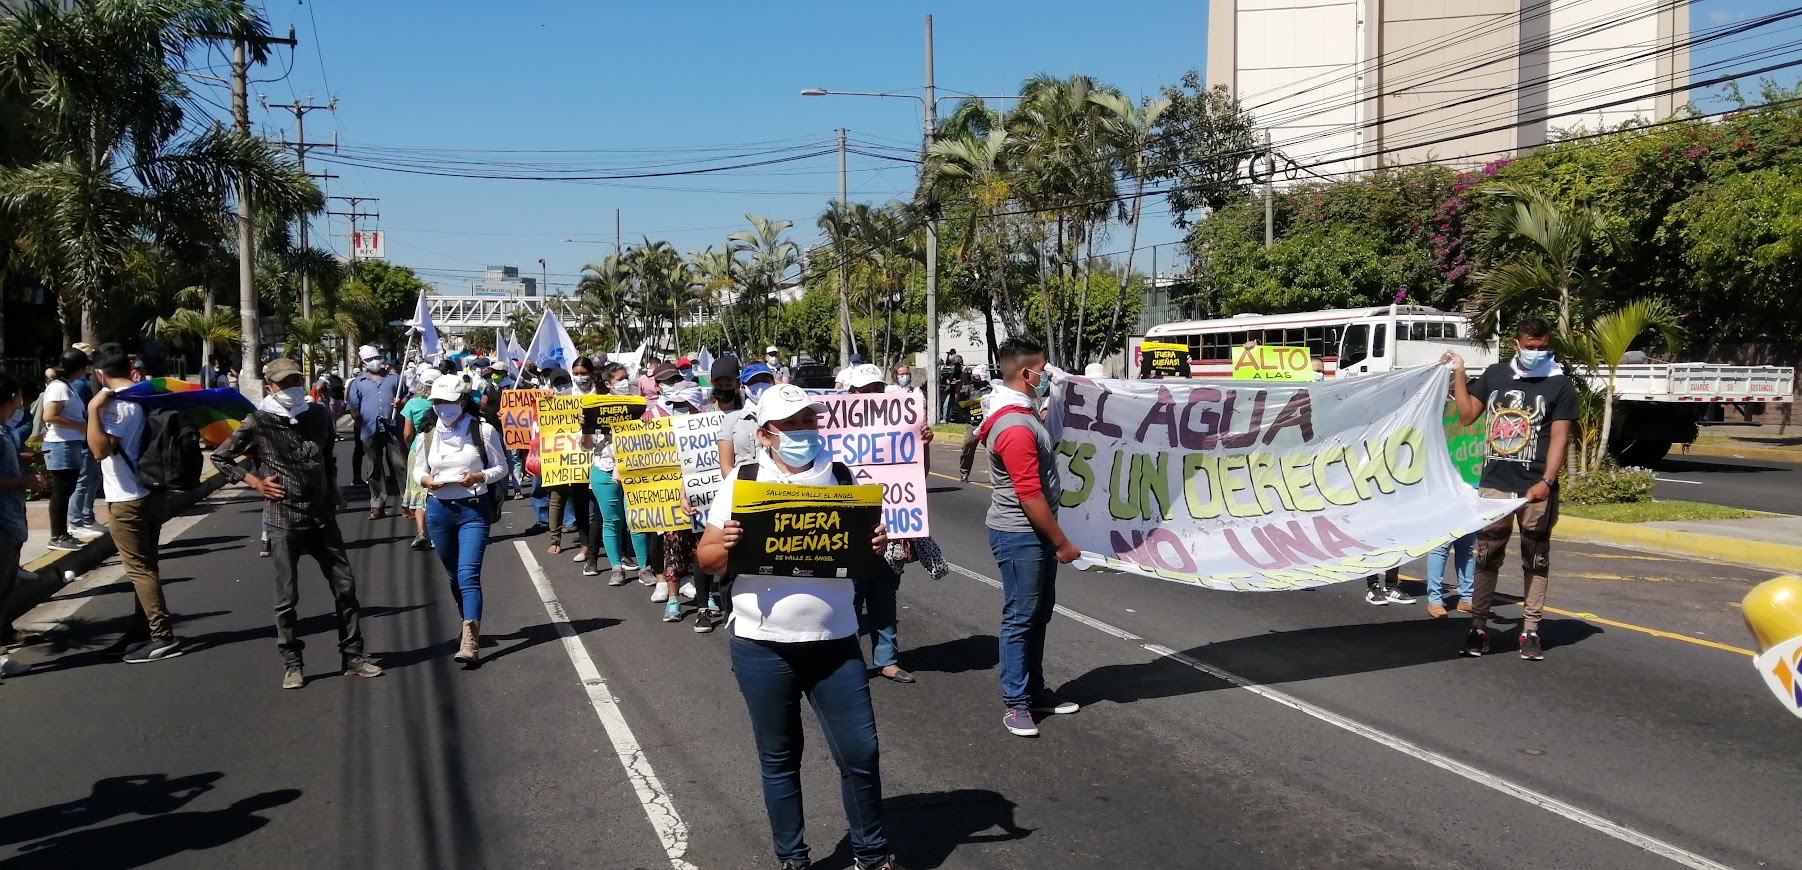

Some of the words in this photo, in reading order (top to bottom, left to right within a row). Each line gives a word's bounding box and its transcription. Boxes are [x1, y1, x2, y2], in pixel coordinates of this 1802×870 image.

[1234, 347, 1308, 371] ALTO
[1266, 371, 1292, 379] LAS
[1727, 383, 1734, 391] SU
[1062, 376, 1123, 439] EL
[503, 411, 532, 428] AG
[687, 414, 725, 430] EXIGI
[1134, 384, 1315, 451] AGUA
[614, 419, 662, 434] EXIGIMOS
[541, 435, 577, 454] LEY
[683, 457, 693, 465] DE
[623, 476, 649, 485] QUE
[687, 474, 722, 487] QUE
[855, 468, 873, 479] A
[1109, 450, 1171, 521] UN
[1183, 426, 1425, 520] DERECHO
[766, 489, 800, 497] SALVEMOS
[774, 511, 841, 533] ¡FUERA
[881, 507, 923, 533] HOS
[765, 530, 850, 554] DUEÑAS!
[1110, 526, 1198, 574] NO
[1224, 515, 1377, 571] UNA
